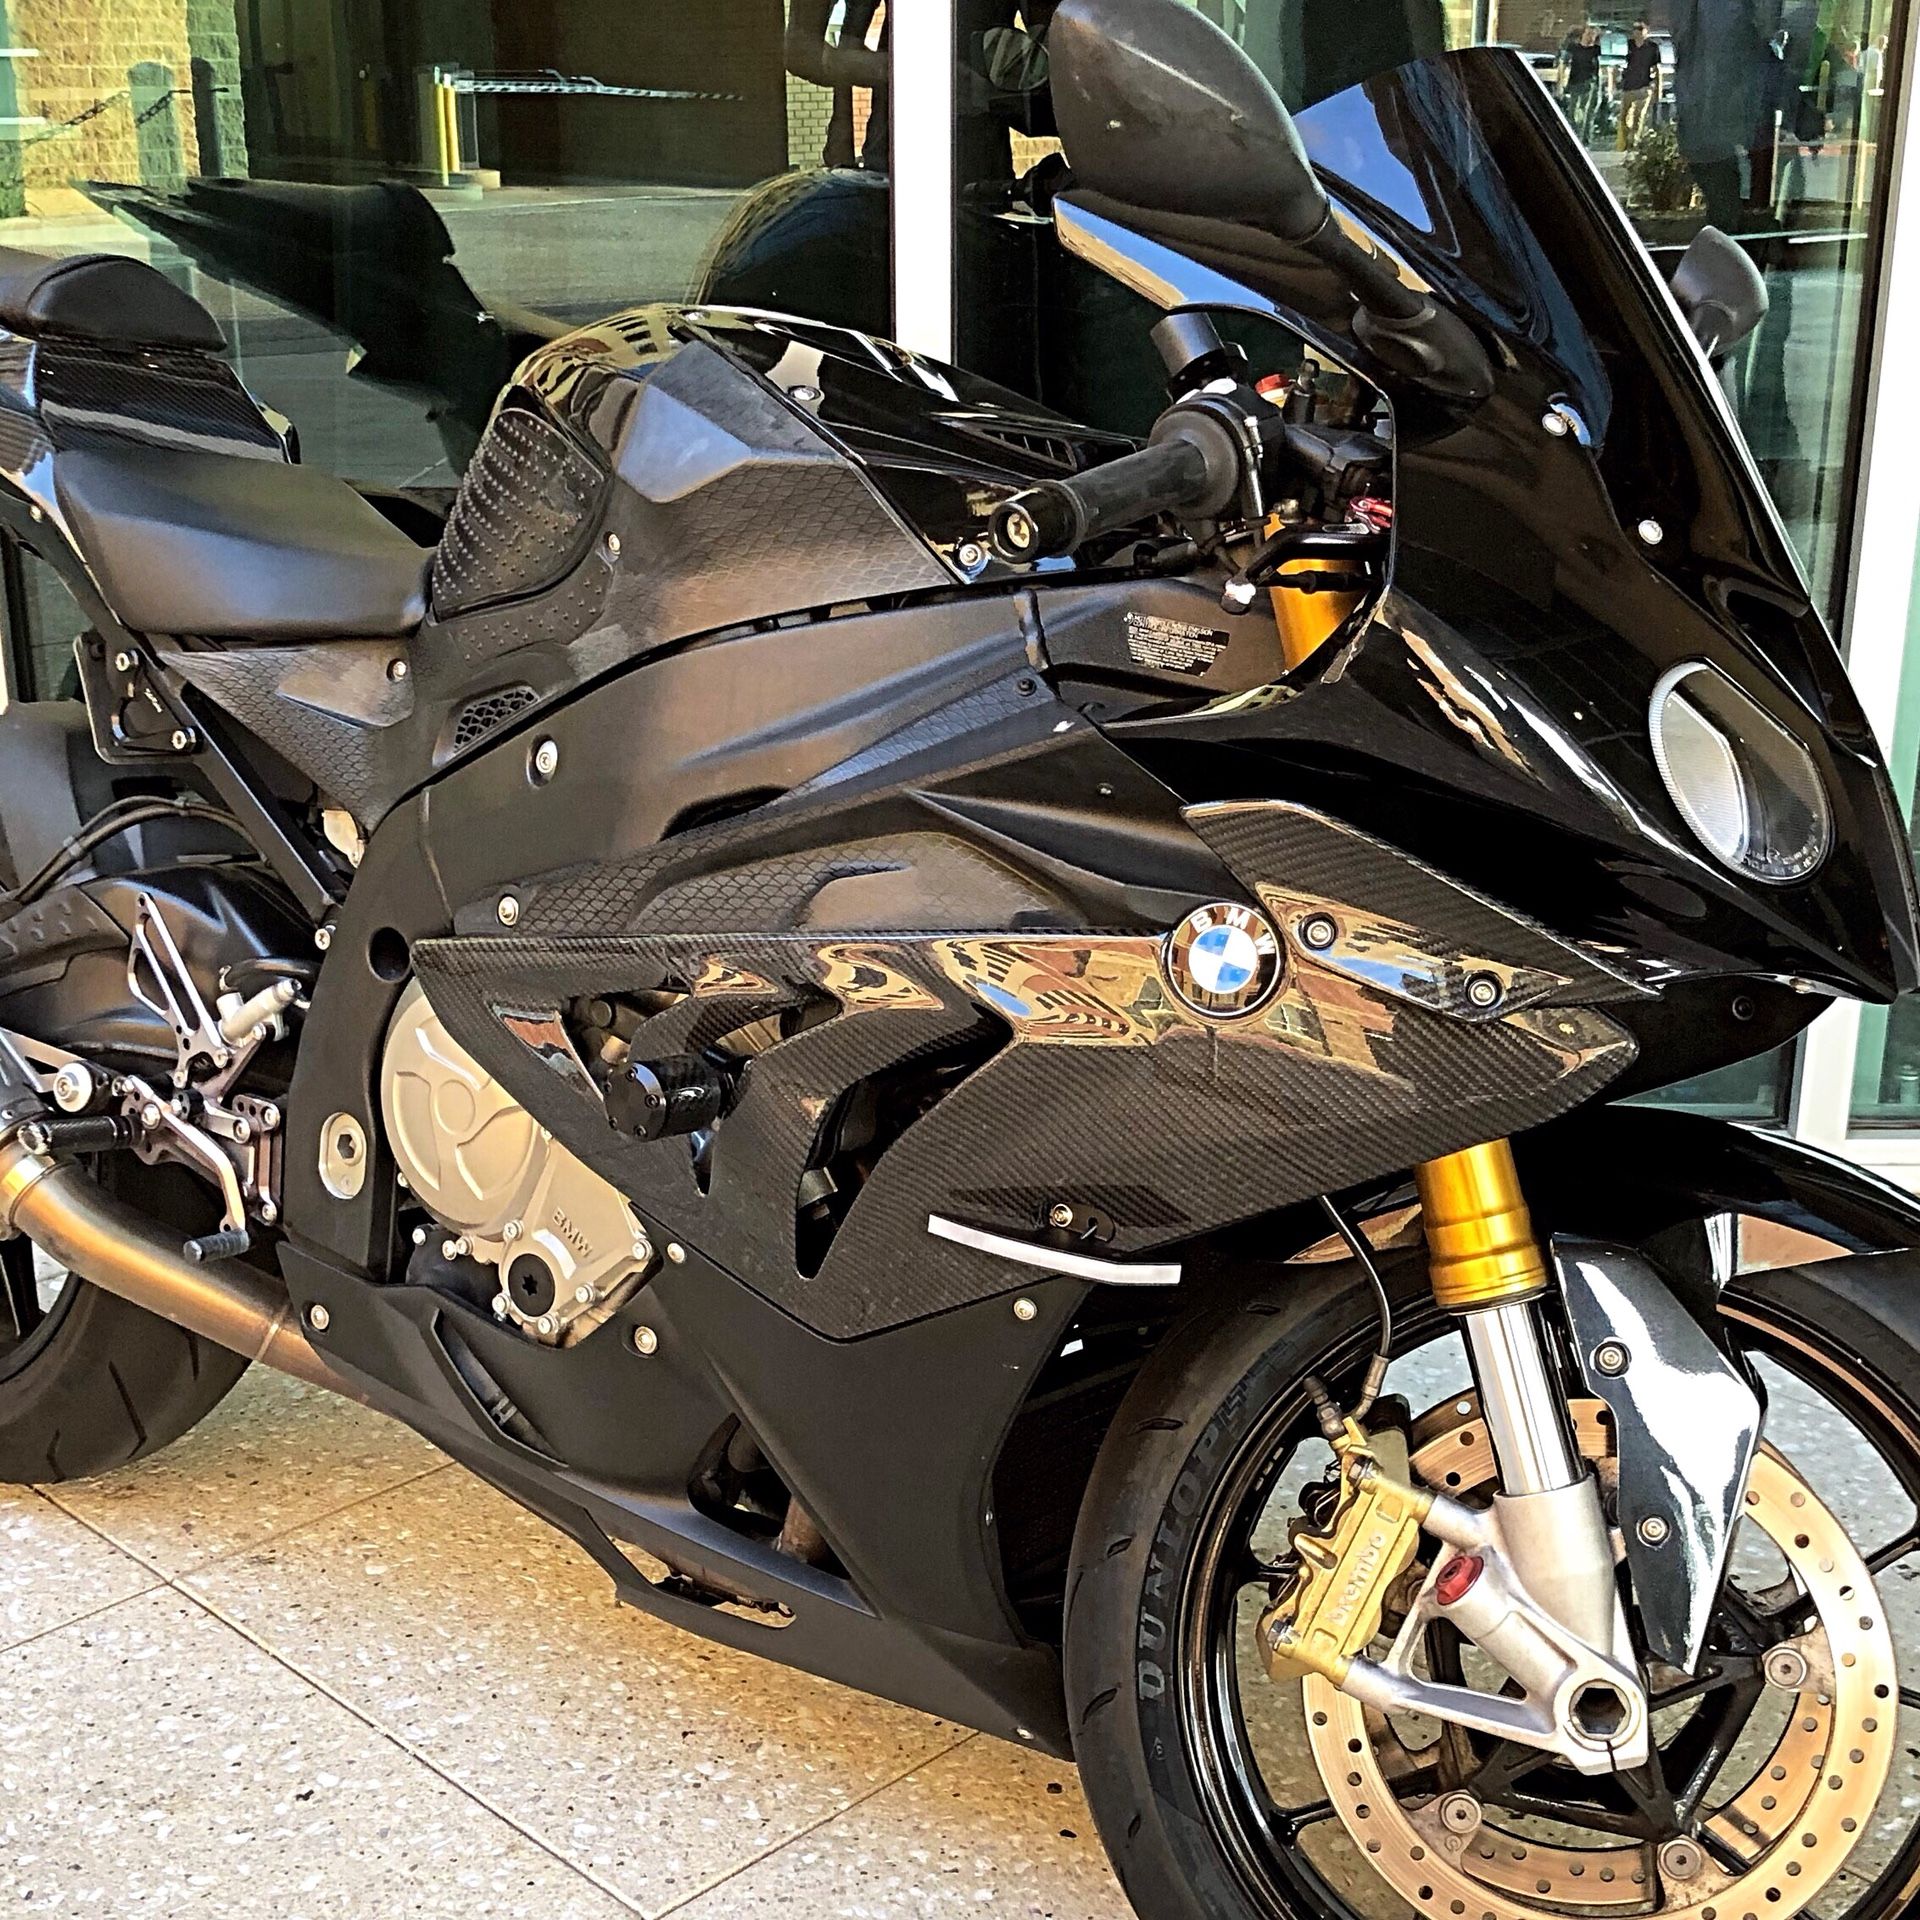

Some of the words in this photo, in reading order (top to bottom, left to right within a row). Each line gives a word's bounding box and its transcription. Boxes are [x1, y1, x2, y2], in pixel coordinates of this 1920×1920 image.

[1190, 906, 1276, 956] BMW
[552, 1207, 593, 1258] BMW
[1138, 1424, 1220, 1701] DUNLOP
[1326, 1531, 1386, 1627] brembo
